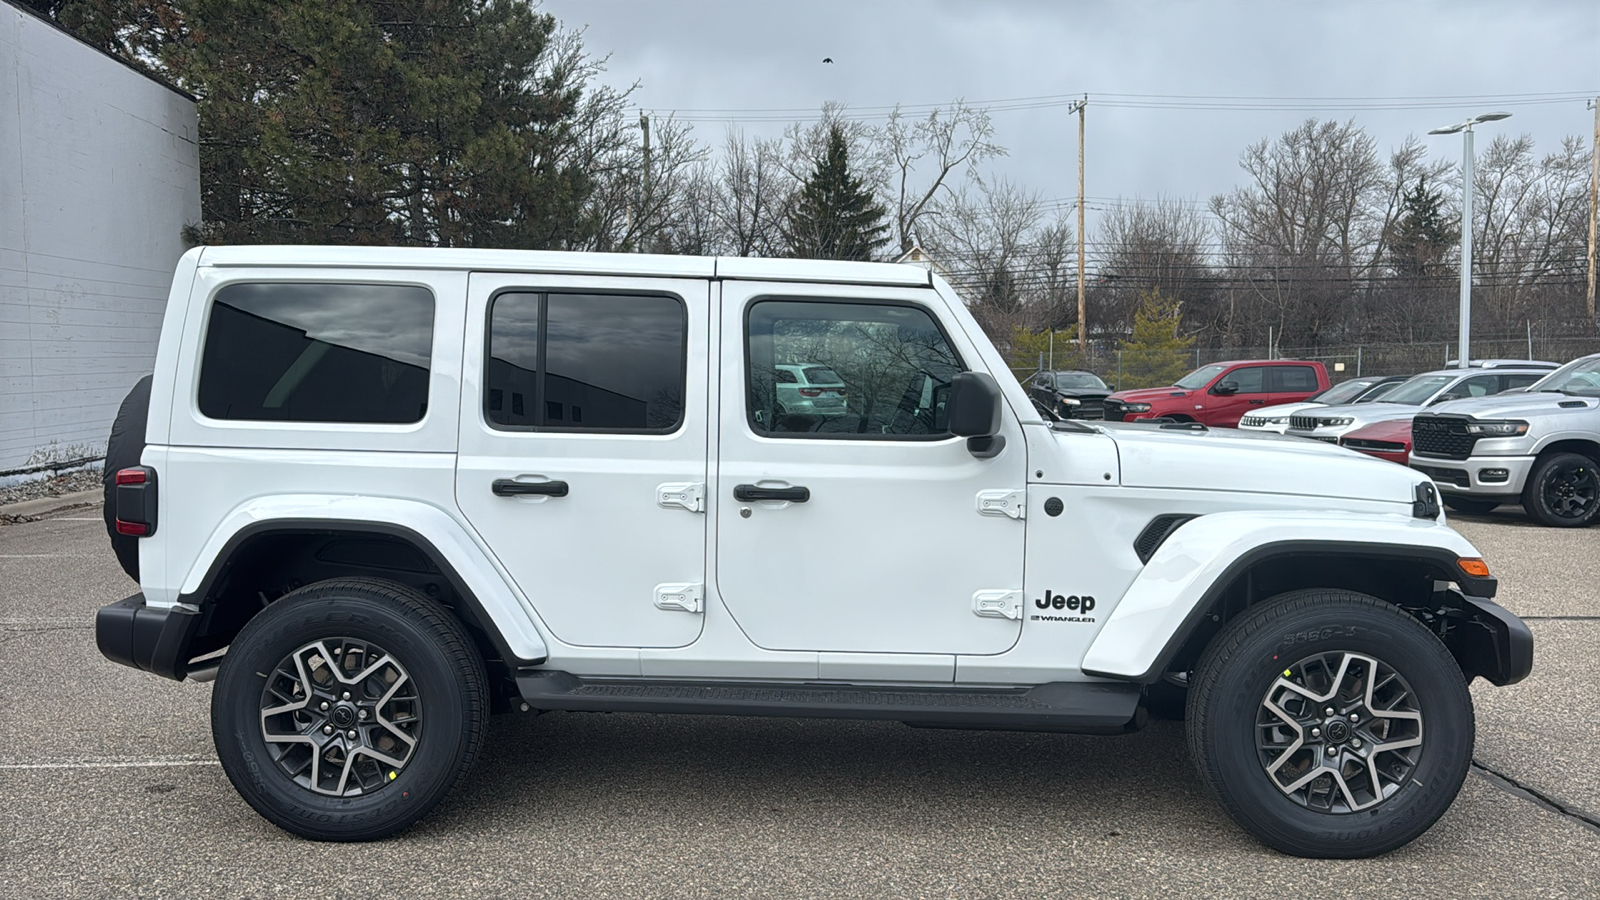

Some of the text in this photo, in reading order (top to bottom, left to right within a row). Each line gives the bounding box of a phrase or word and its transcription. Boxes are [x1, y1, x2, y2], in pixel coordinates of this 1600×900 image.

[1420, 422, 1448, 431] RAM
[1035, 589, 1096, 615] Jeep
[1041, 615, 1096, 623] WRANGLER
